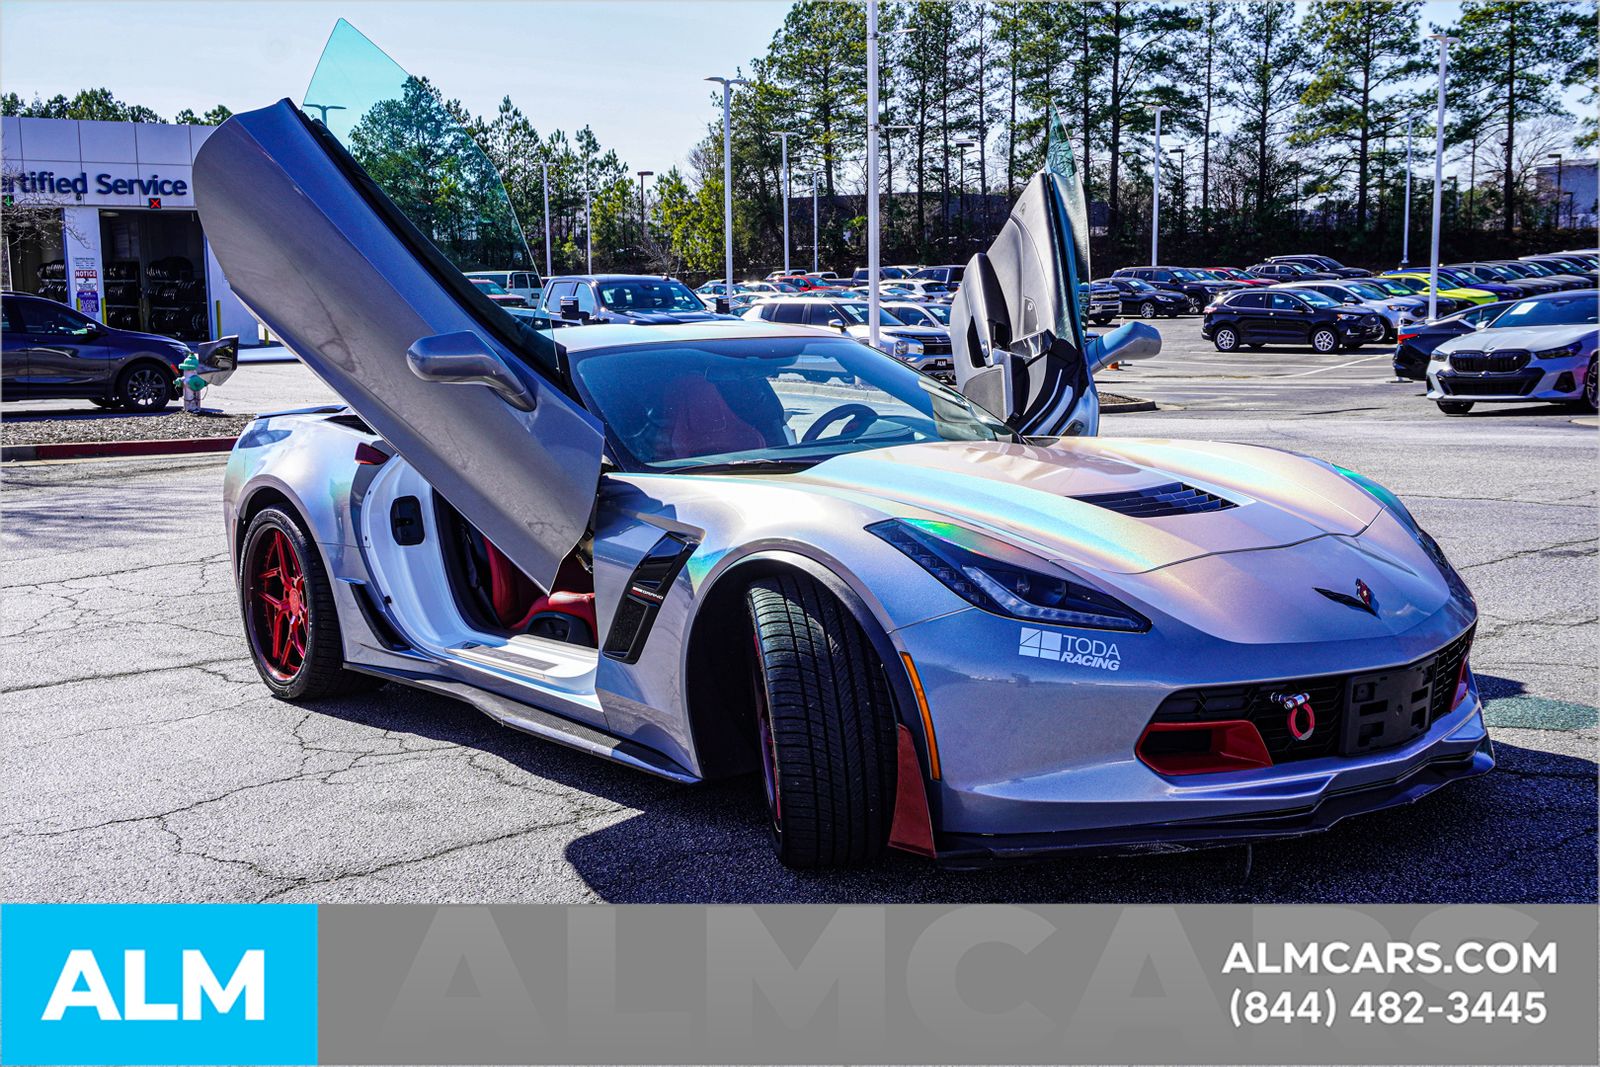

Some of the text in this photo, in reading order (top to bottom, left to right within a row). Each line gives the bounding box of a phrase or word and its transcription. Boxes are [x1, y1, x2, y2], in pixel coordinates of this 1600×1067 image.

[96, 173, 188, 196] Service
[1063, 634, 1121, 660] TODA
[1060, 651, 1120, 671] RACING
